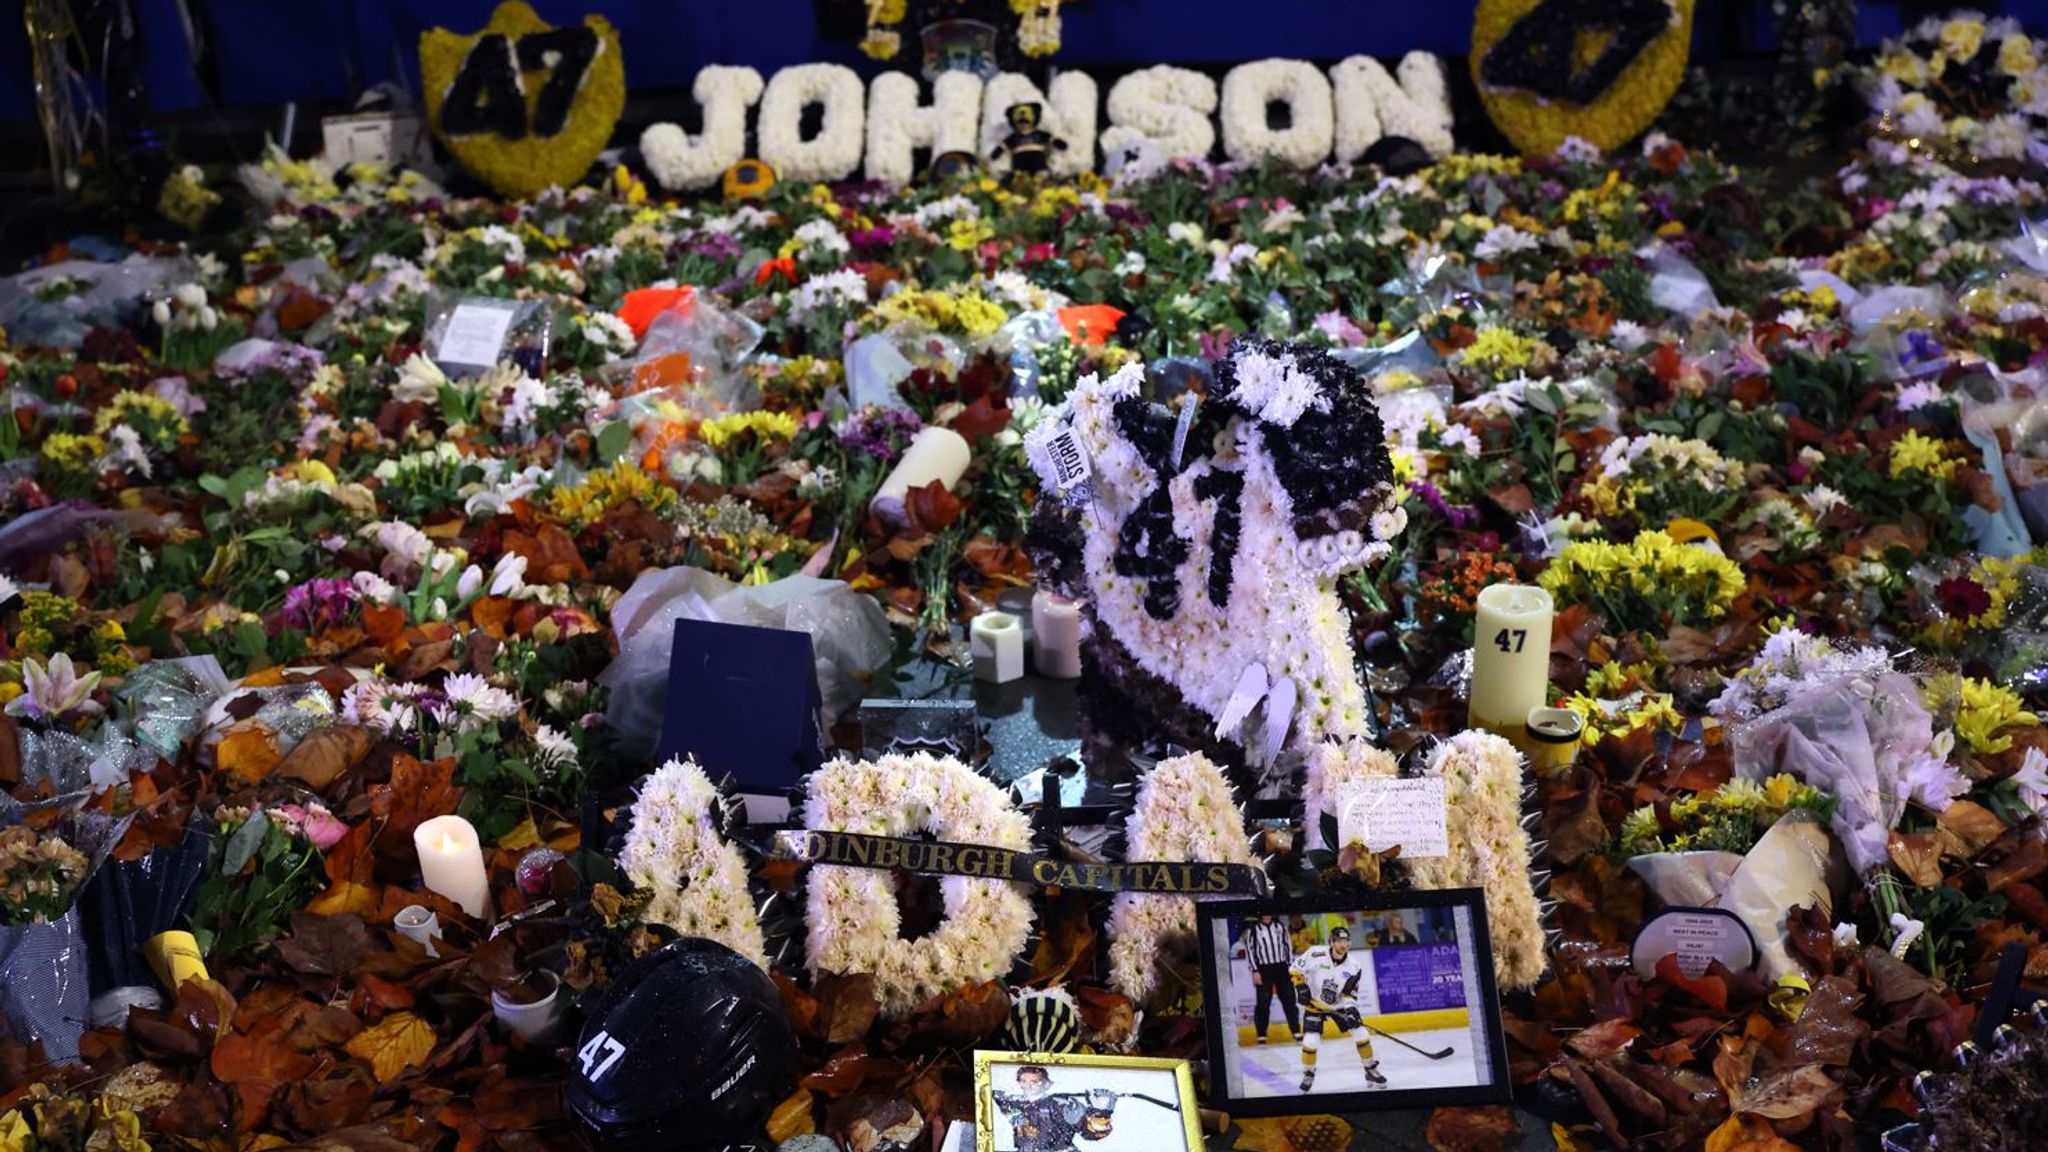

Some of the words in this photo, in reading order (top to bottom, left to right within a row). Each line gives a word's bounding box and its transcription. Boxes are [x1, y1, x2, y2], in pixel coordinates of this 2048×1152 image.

[441, 27, 605, 140] 47
[640, 50, 1455, 191] JOHNSON
[1046, 440, 1068, 484] MANCHESTER
[1054, 432, 1084, 480] STORM
[1493, 628, 1527, 653] 47
[1033, 860, 1230, 892] CAPITALS
[578, 1030, 627, 1084] 47
[711, 1055, 757, 1101] BAUER
